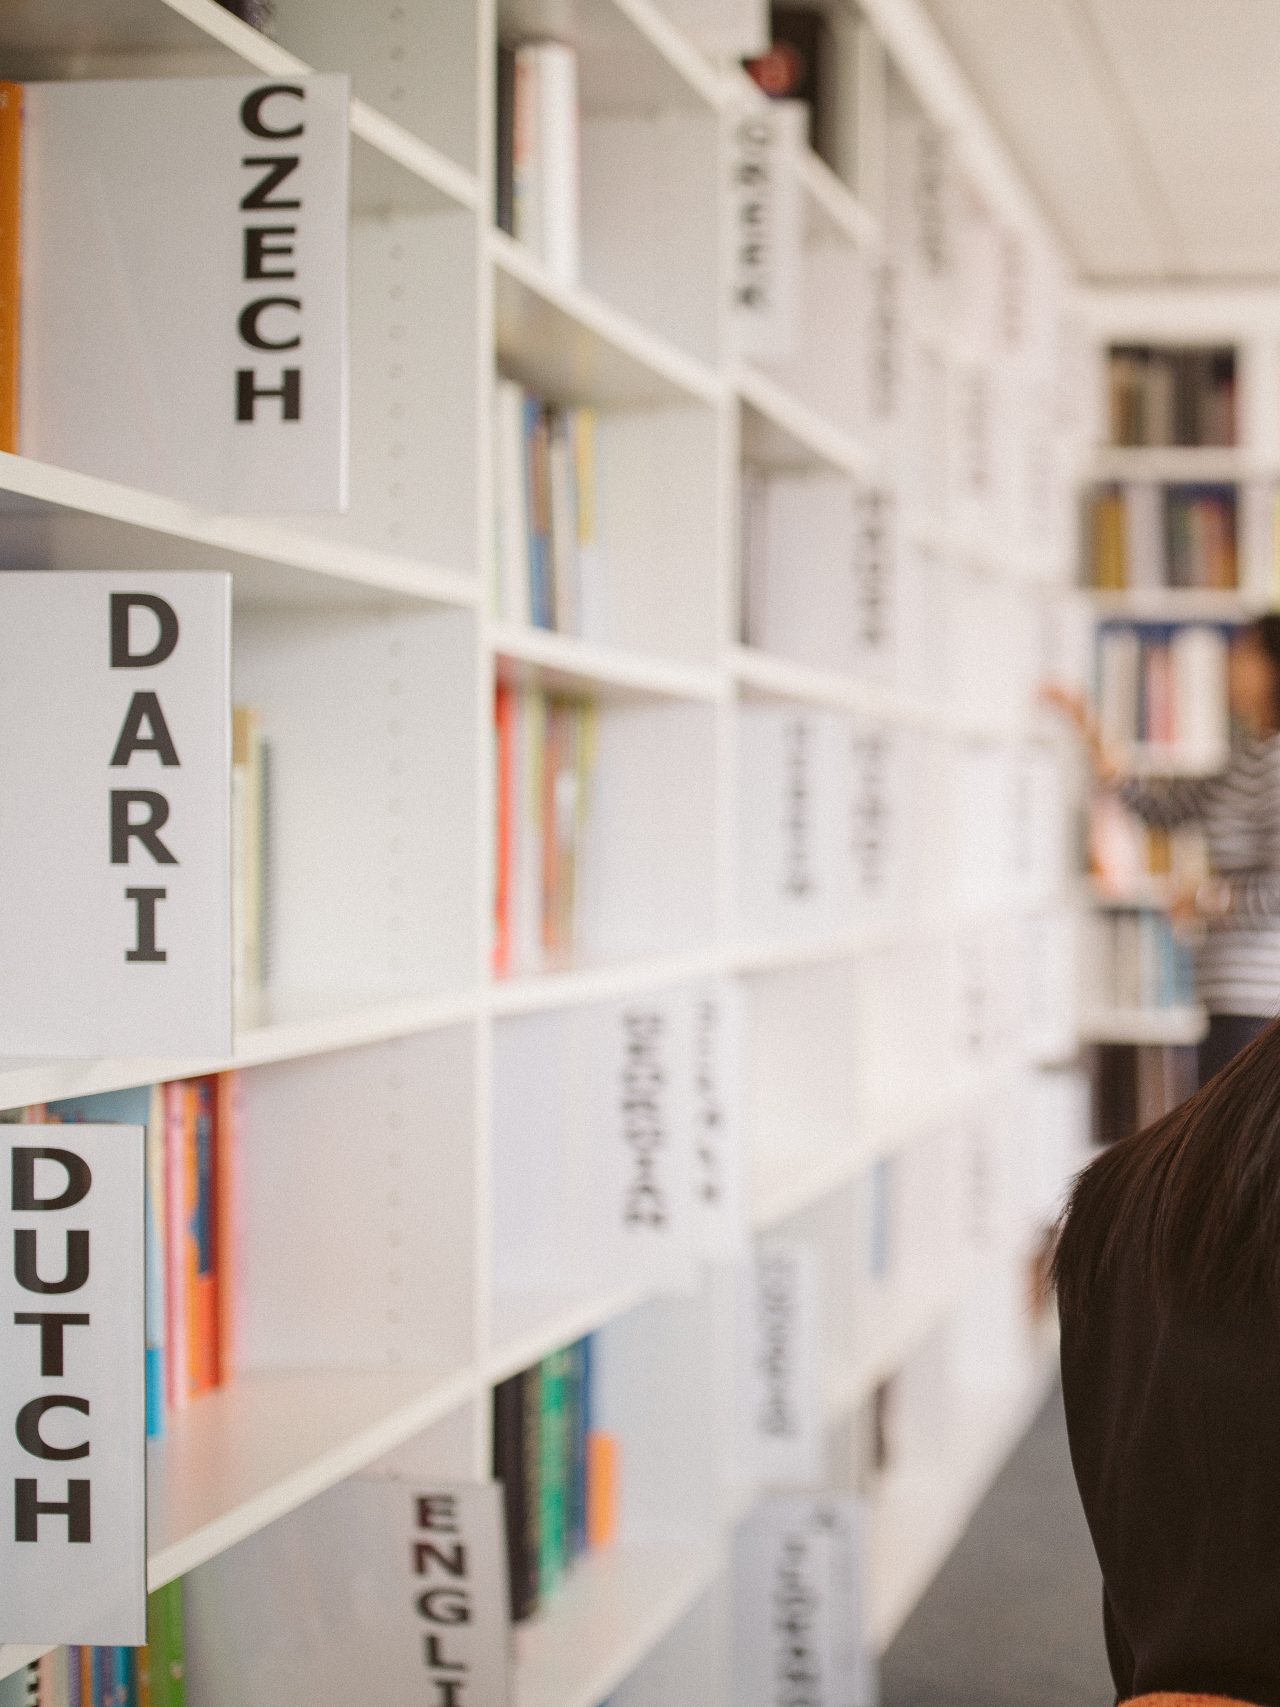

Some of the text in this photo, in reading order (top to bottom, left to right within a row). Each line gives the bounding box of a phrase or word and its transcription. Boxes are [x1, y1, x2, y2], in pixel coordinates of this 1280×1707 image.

[235, 83, 305, 424] CZECH
[109, 592, 181, 961] DARI
[11, 1146, 92, 1543] DUTCH
